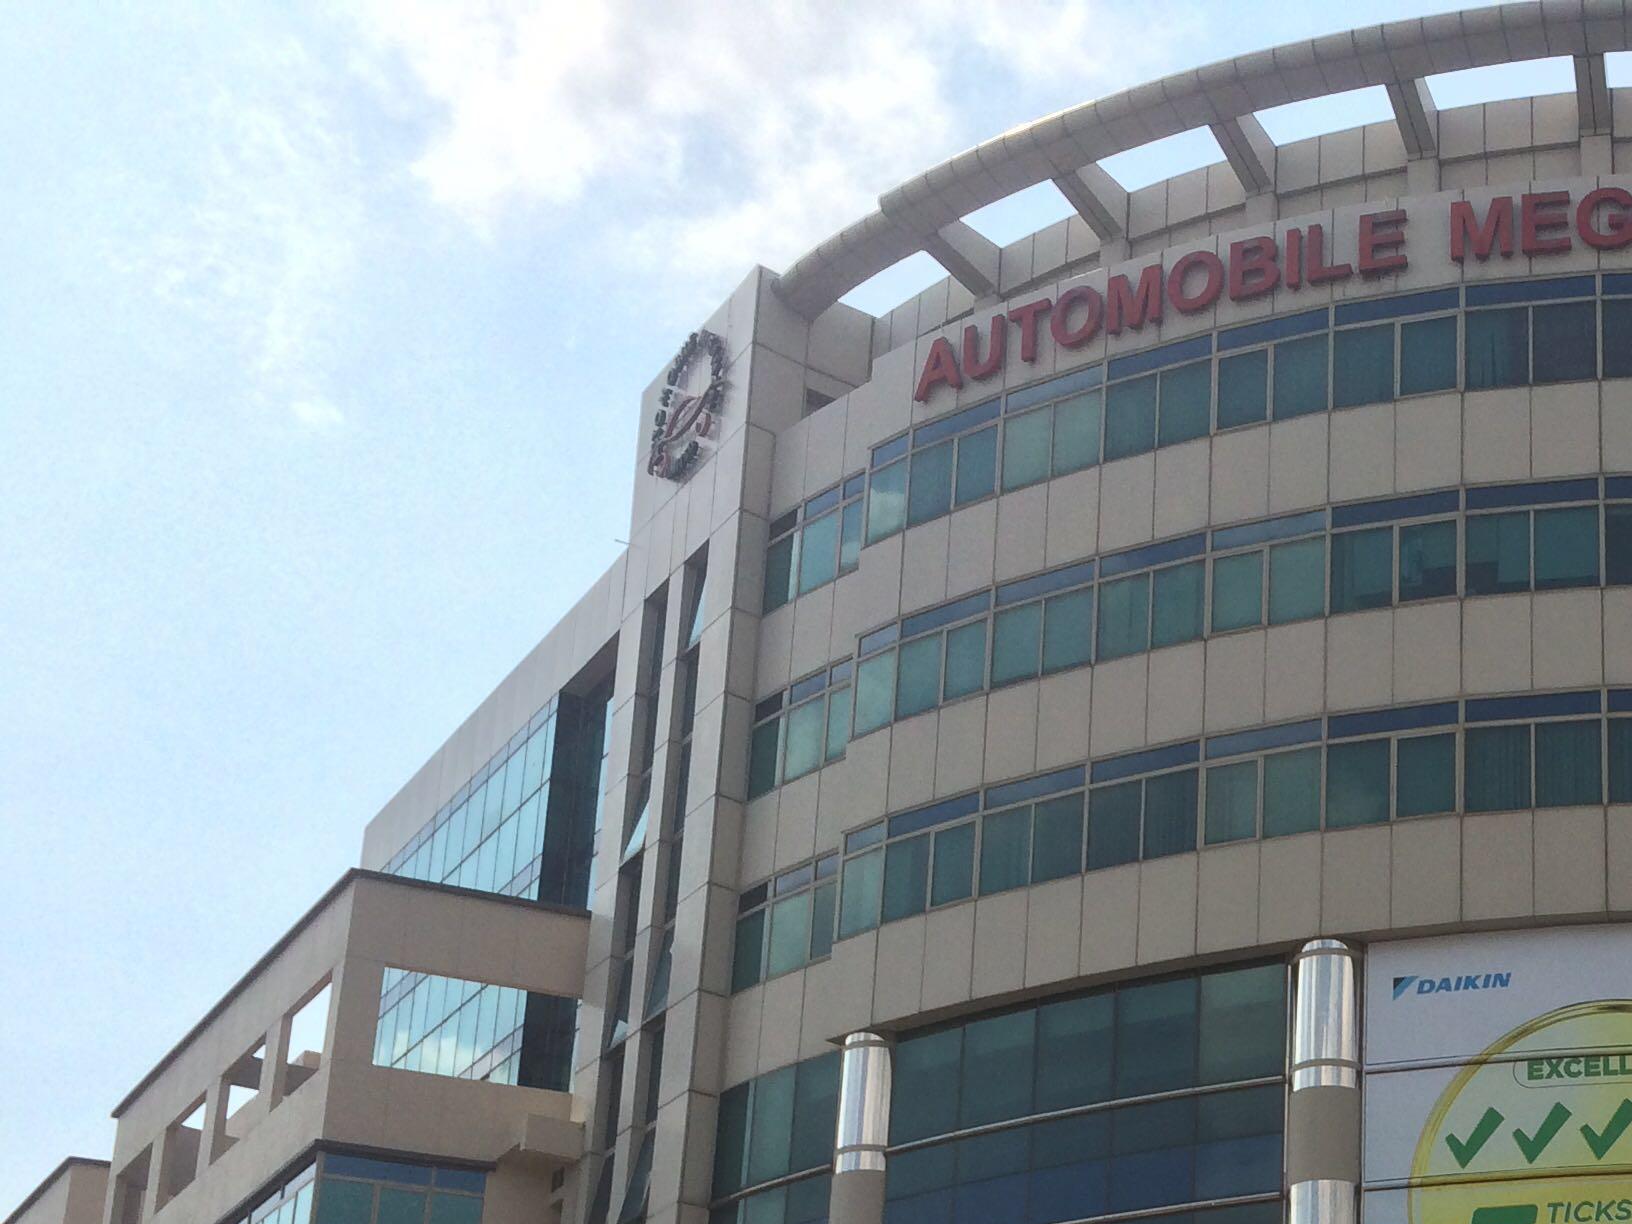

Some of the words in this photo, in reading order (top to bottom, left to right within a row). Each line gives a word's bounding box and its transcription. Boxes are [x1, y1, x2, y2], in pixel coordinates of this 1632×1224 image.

[914, 208, 1408, 402] AUTOMOBILE
[1416, 972, 1512, 996] DAIKIN
[1546, 1199, 1632, 1224] TICKS
